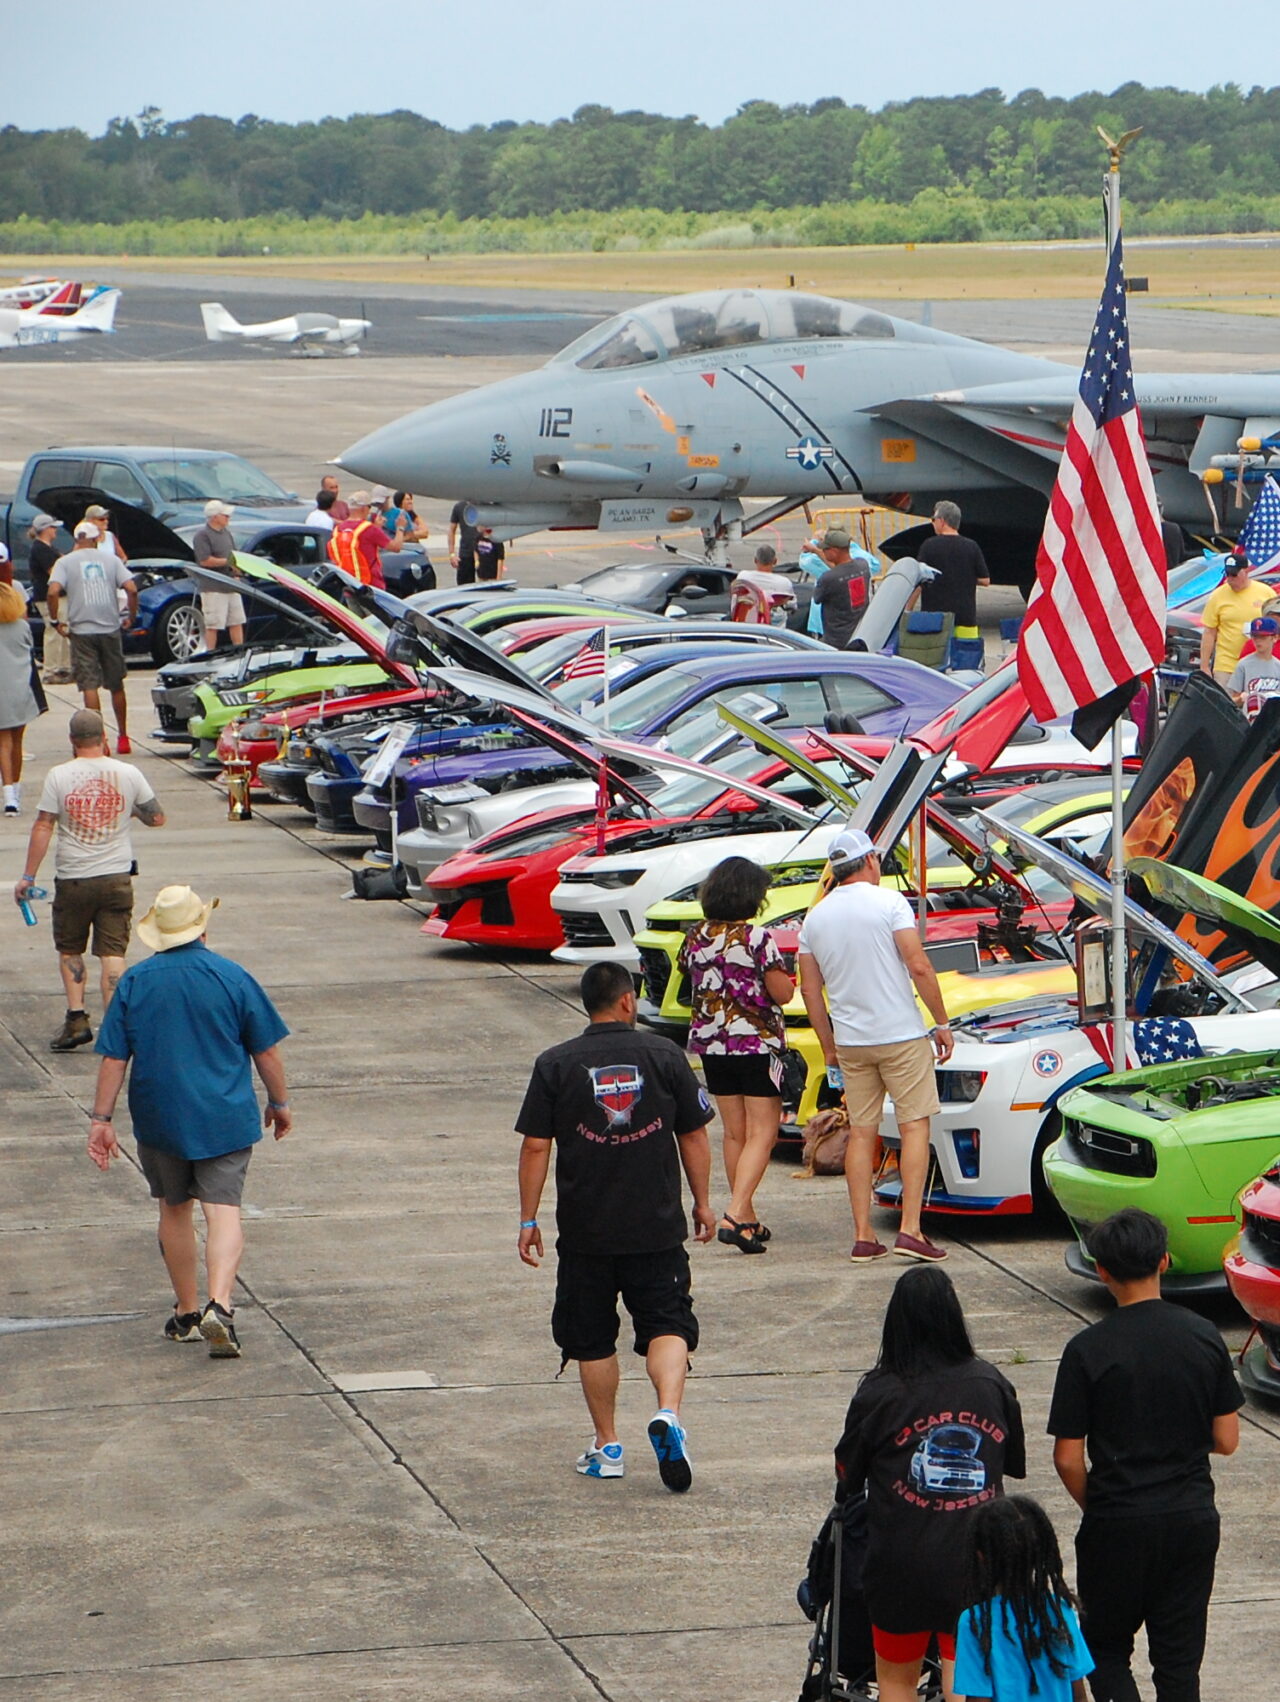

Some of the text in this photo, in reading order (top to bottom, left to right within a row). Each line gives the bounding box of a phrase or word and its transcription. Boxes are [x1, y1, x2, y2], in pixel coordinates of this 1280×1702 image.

[538, 407, 573, 438] 112
[576, 1117, 663, 1145] New Jersey
[913, 1411, 953, 1433] CAR
[958, 1411, 1005, 1444] CLUB
[892, 1480, 997, 1512] New Jersey
